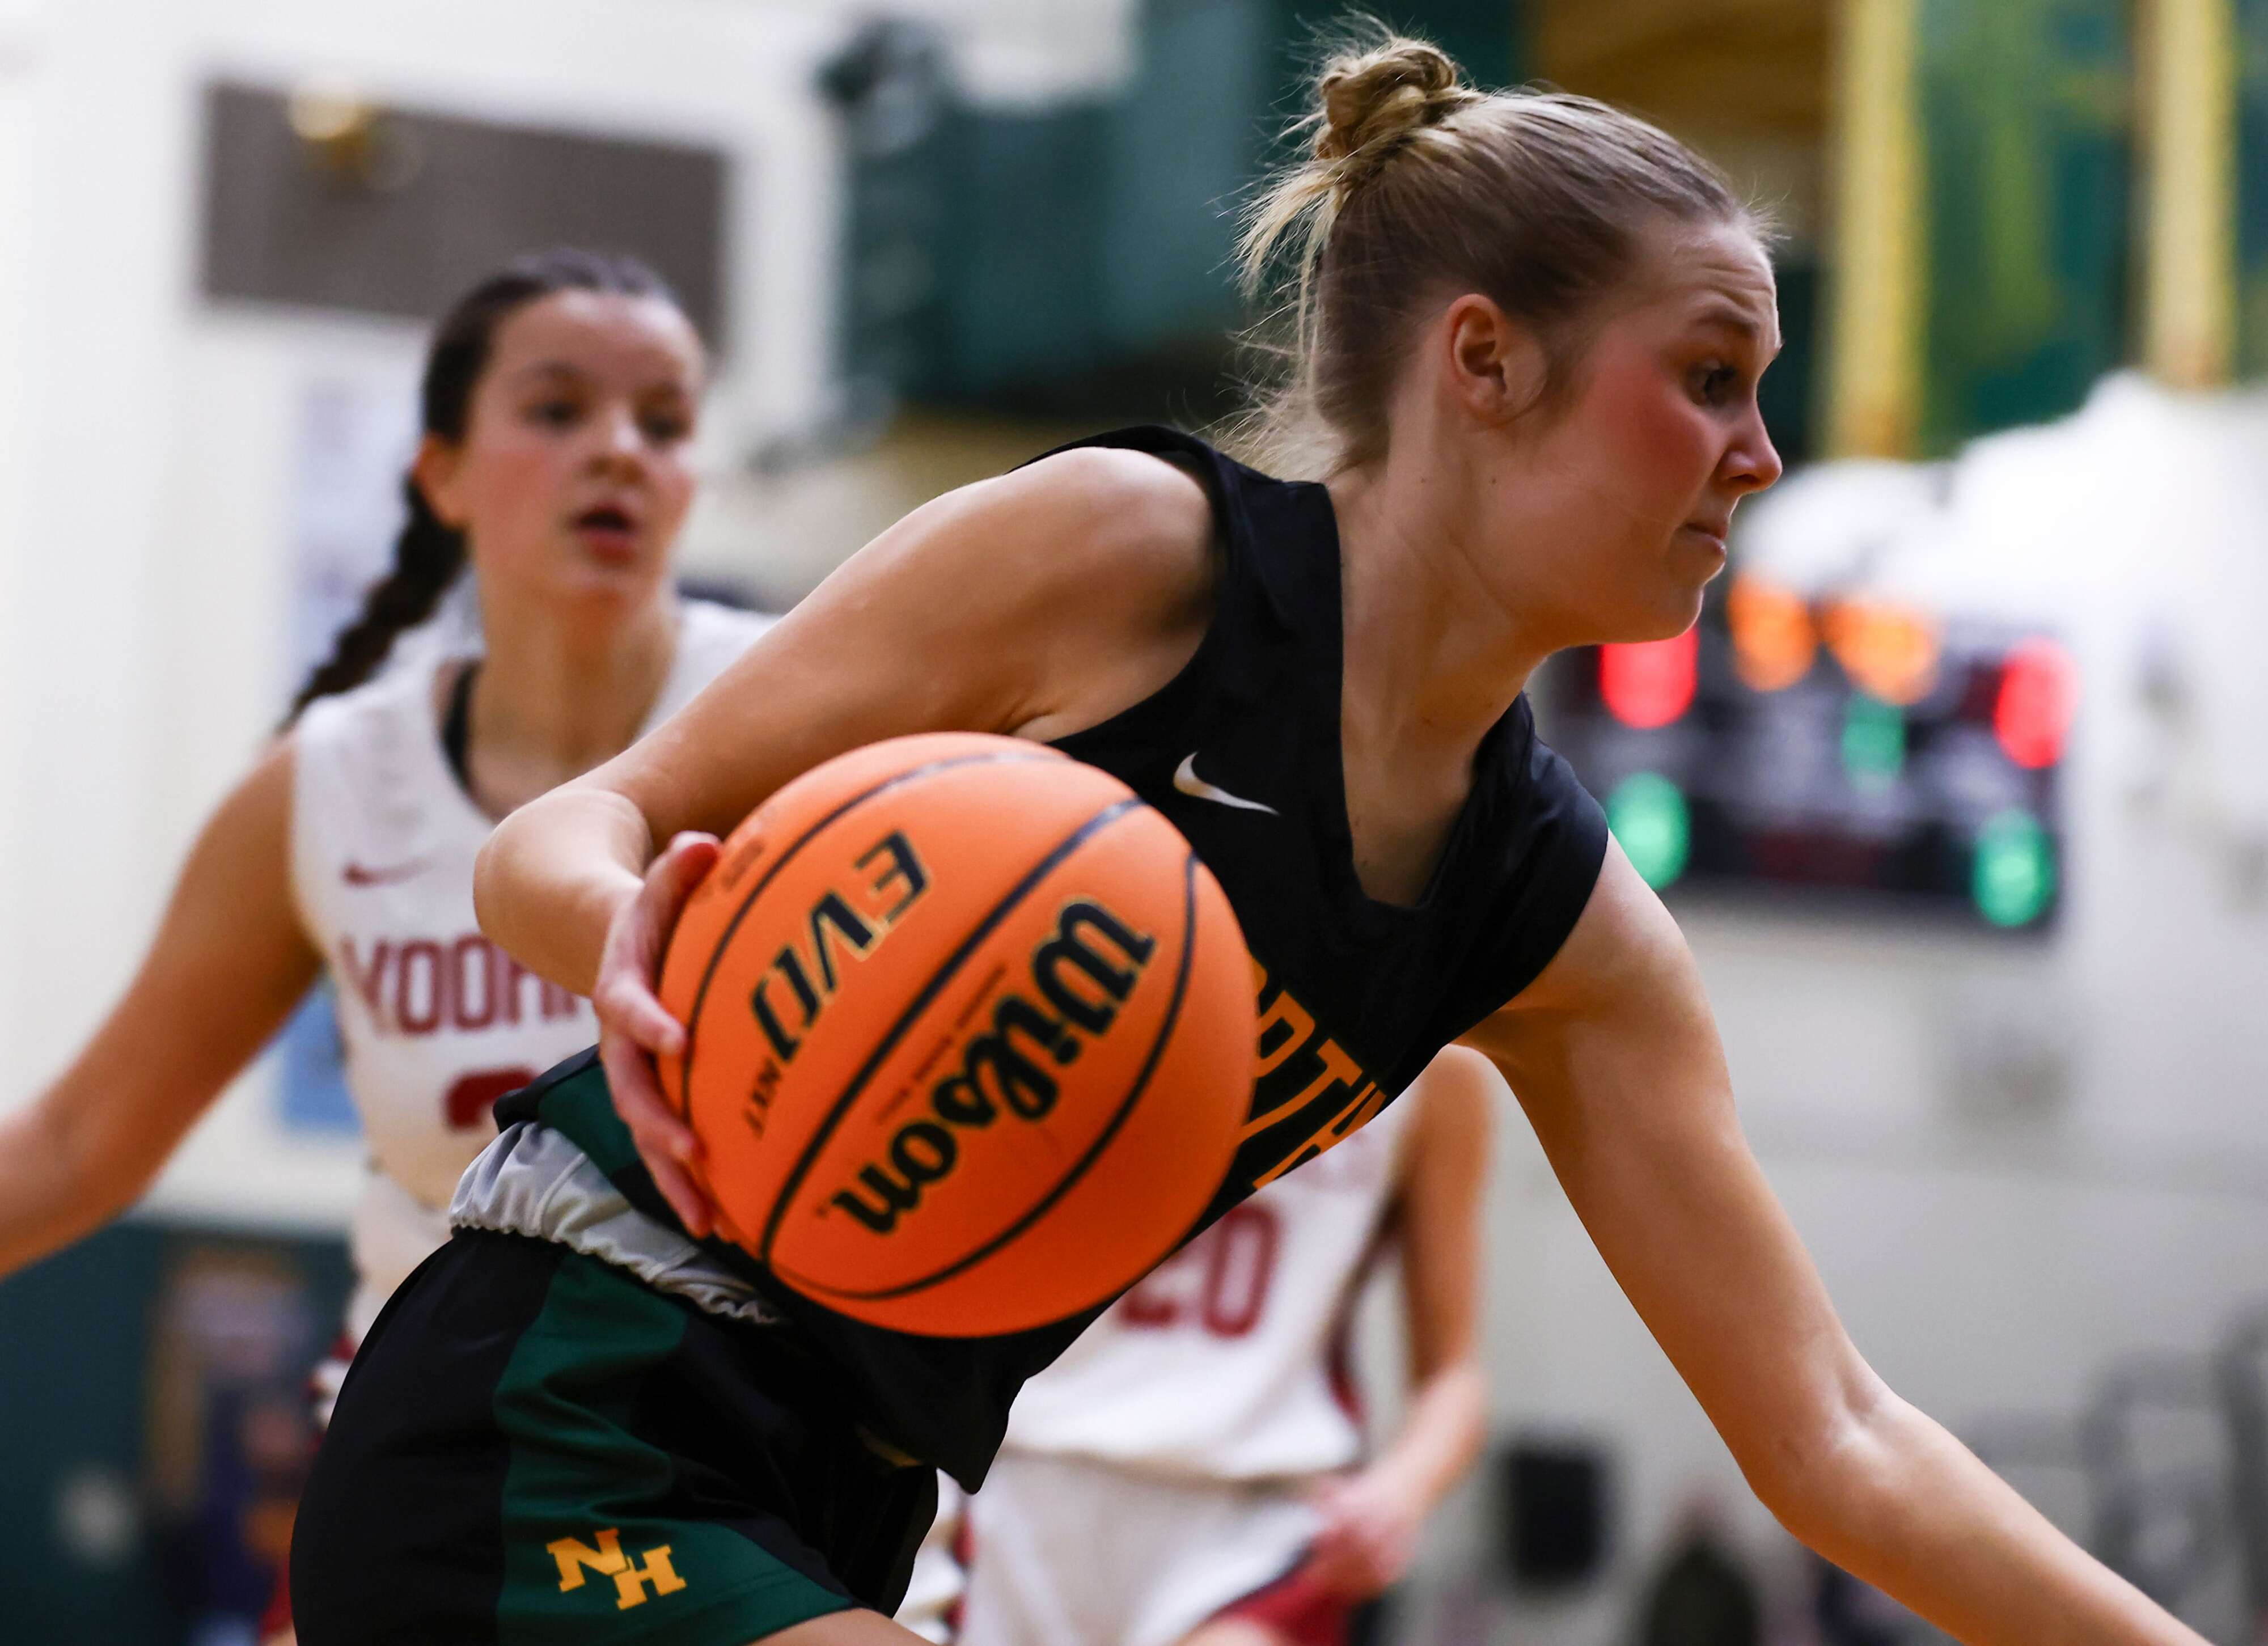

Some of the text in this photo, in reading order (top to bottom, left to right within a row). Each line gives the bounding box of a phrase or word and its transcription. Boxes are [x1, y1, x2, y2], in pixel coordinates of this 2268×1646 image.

[748, 828, 930, 1063] EVO
[830, 897, 1156, 1236] Wilson
[545, 1526, 687, 1611] NH
